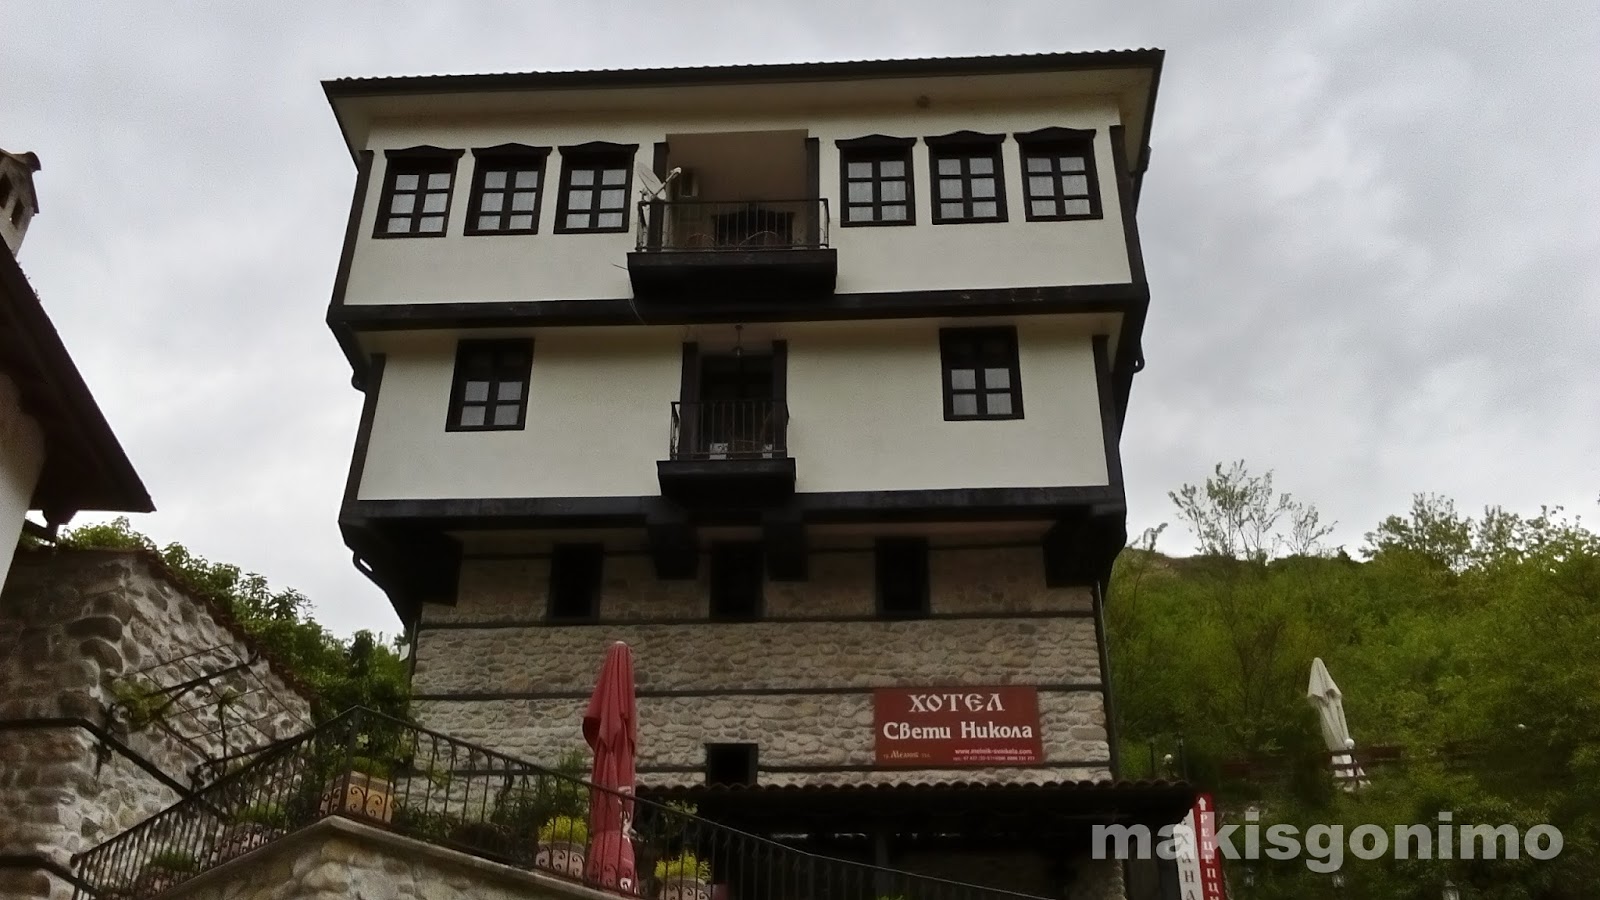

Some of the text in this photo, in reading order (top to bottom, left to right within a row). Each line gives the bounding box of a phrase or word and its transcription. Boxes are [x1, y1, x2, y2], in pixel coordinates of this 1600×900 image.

[908, 693, 1006, 712] ХОТЕЛ
[883, 720, 1033, 740] Свети Никола
